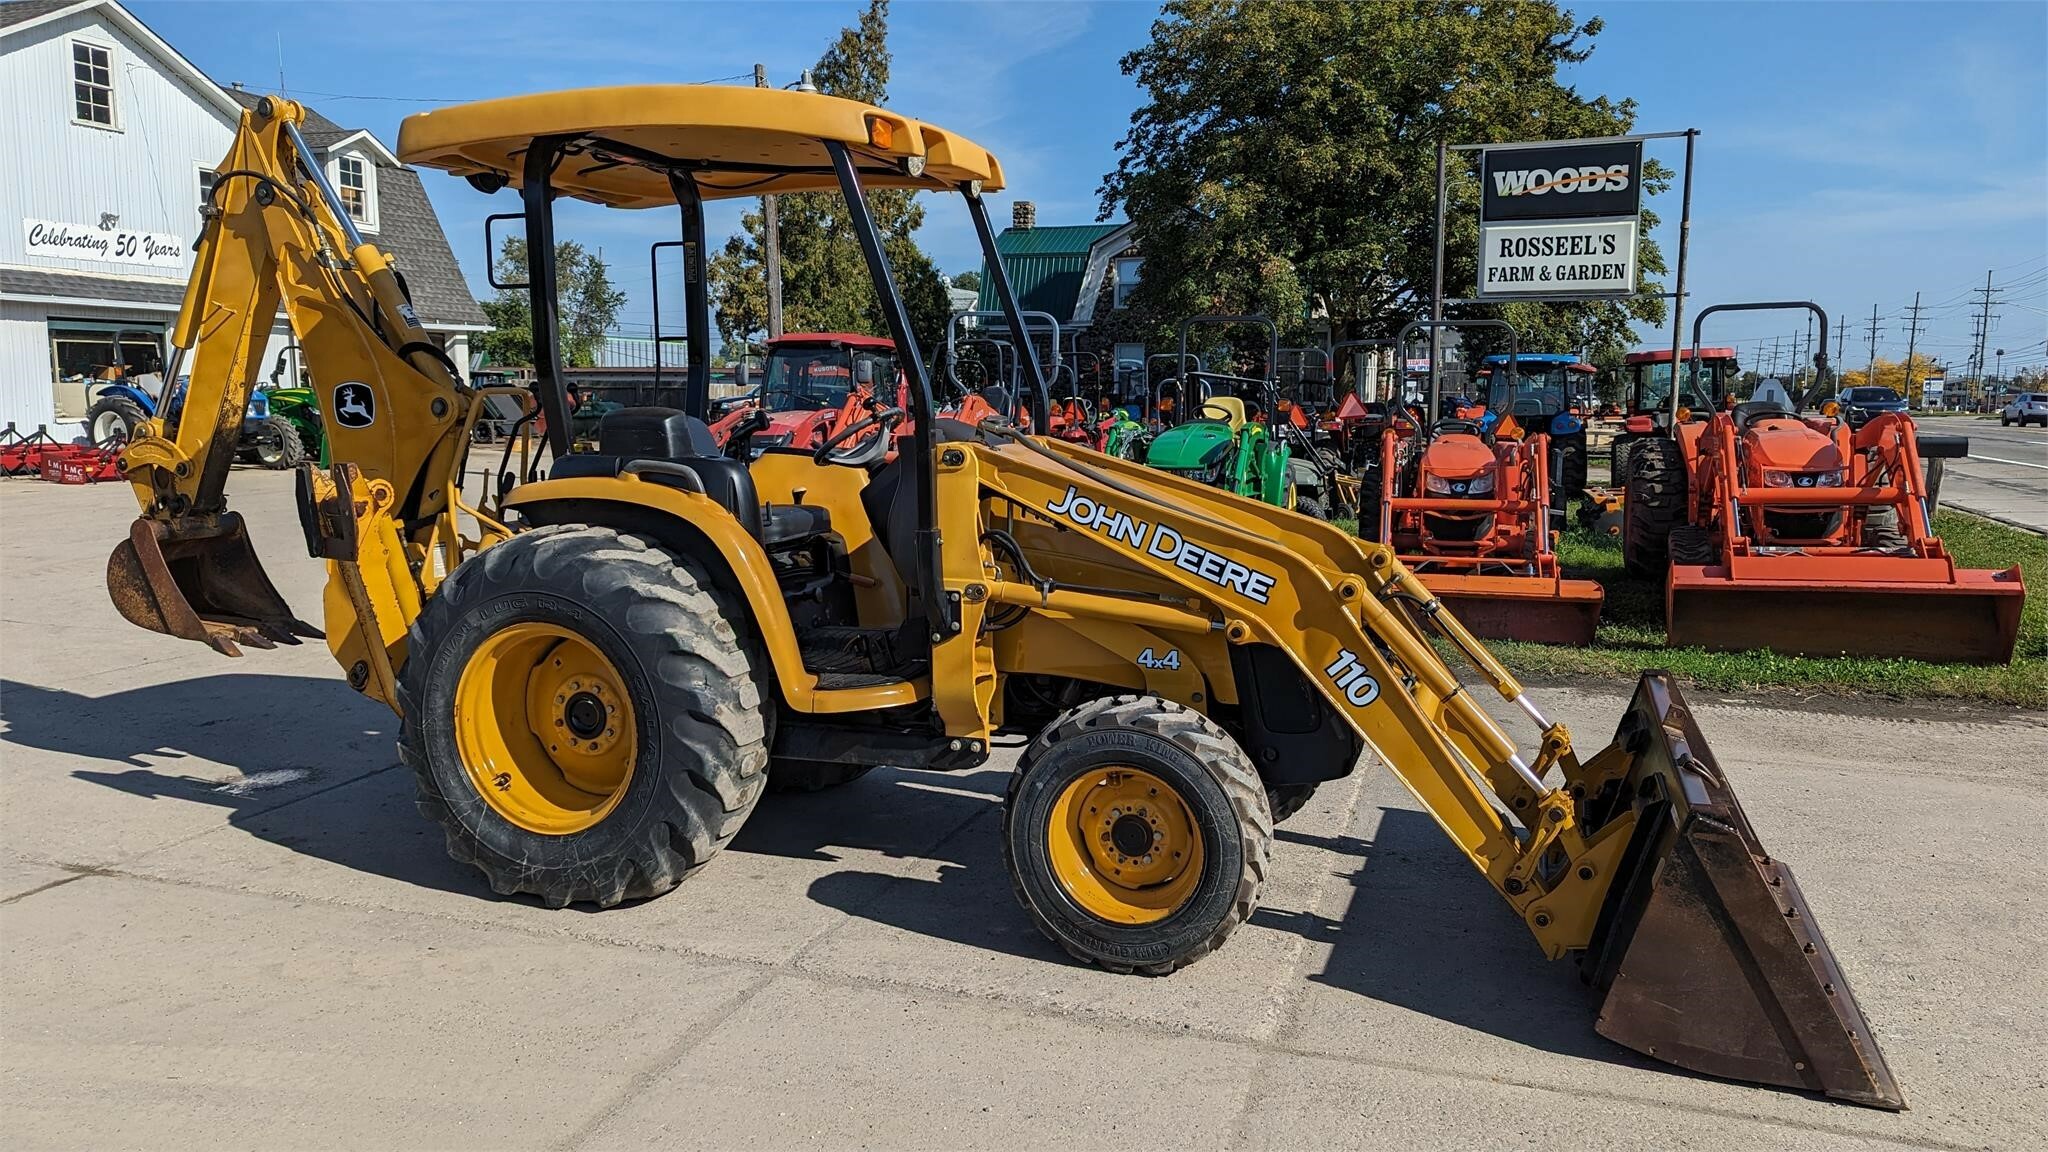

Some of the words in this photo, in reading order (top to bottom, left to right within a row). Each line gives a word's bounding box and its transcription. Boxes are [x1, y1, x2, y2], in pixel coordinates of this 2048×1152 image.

[1493, 164, 1630, 197] WOODS
[28, 223, 109, 257] Celebrating
[115, 234, 137, 257] 50
[143, 236, 181, 260] Years
[1499, 234, 1616, 258] ROSSEEL'S
[1488, 266, 1535, 282] FARM
[1538, 265, 1552, 281] &
[1556, 263, 1626, 281] GARDEN
[1047, 484, 1149, 549] JOHN
[1147, 522, 1277, 606] DEERE
[1136, 648, 1180, 671] 4x4
[1323, 647, 1382, 708] 110
[1085, 731, 1138, 749] POWER
[1143, 737, 1181, 765] KING
